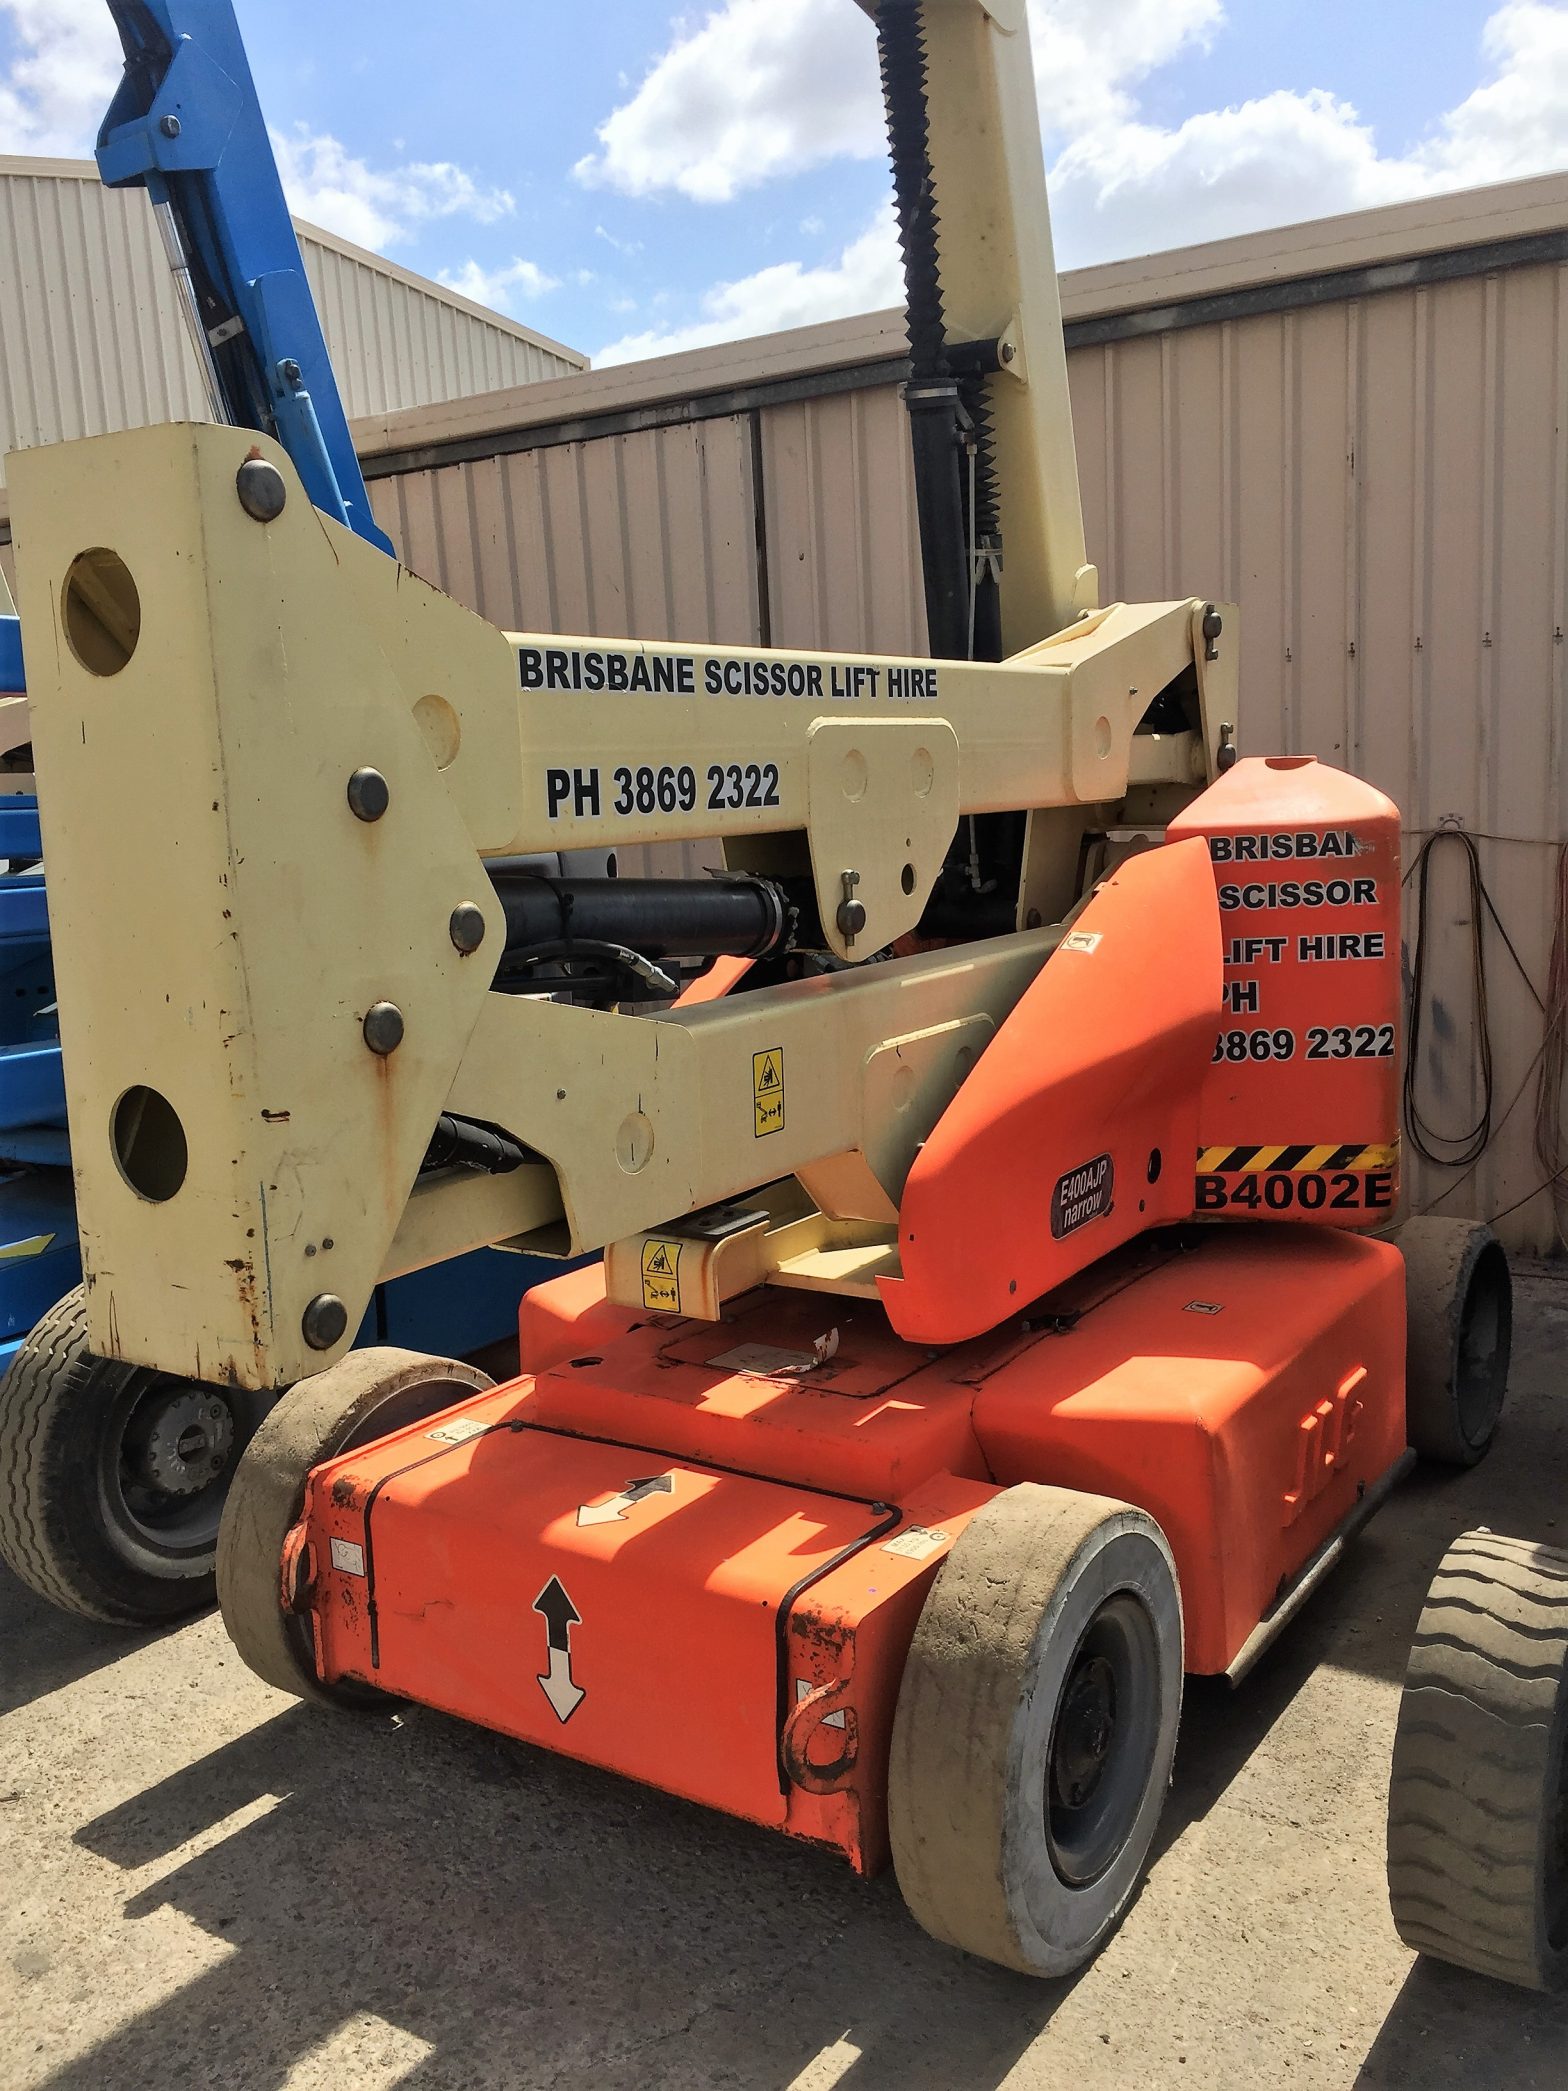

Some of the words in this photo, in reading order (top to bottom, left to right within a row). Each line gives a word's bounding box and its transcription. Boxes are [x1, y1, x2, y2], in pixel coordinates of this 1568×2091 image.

[519, 648, 695, 693] BRISBANE
[705, 660, 823, 697] SCISSOR
[831, 666, 880, 698] LIFT
[888, 668, 937, 697] HIRE
[547, 768, 600, 818] PH
[614, 766, 696, 815] 3869
[707, 764, 779, 810] 2322
[1219, 880, 1377, 910] SCISSOR
[1300, 933, 1384, 960] HIRE
[1307, 1025, 1394, 1059] 2322
[1060, 1160, 1107, 1206] E400AJP
[1195, 1173, 1392, 1210] B4002E
[1063, 1190, 1102, 1229] narrow
